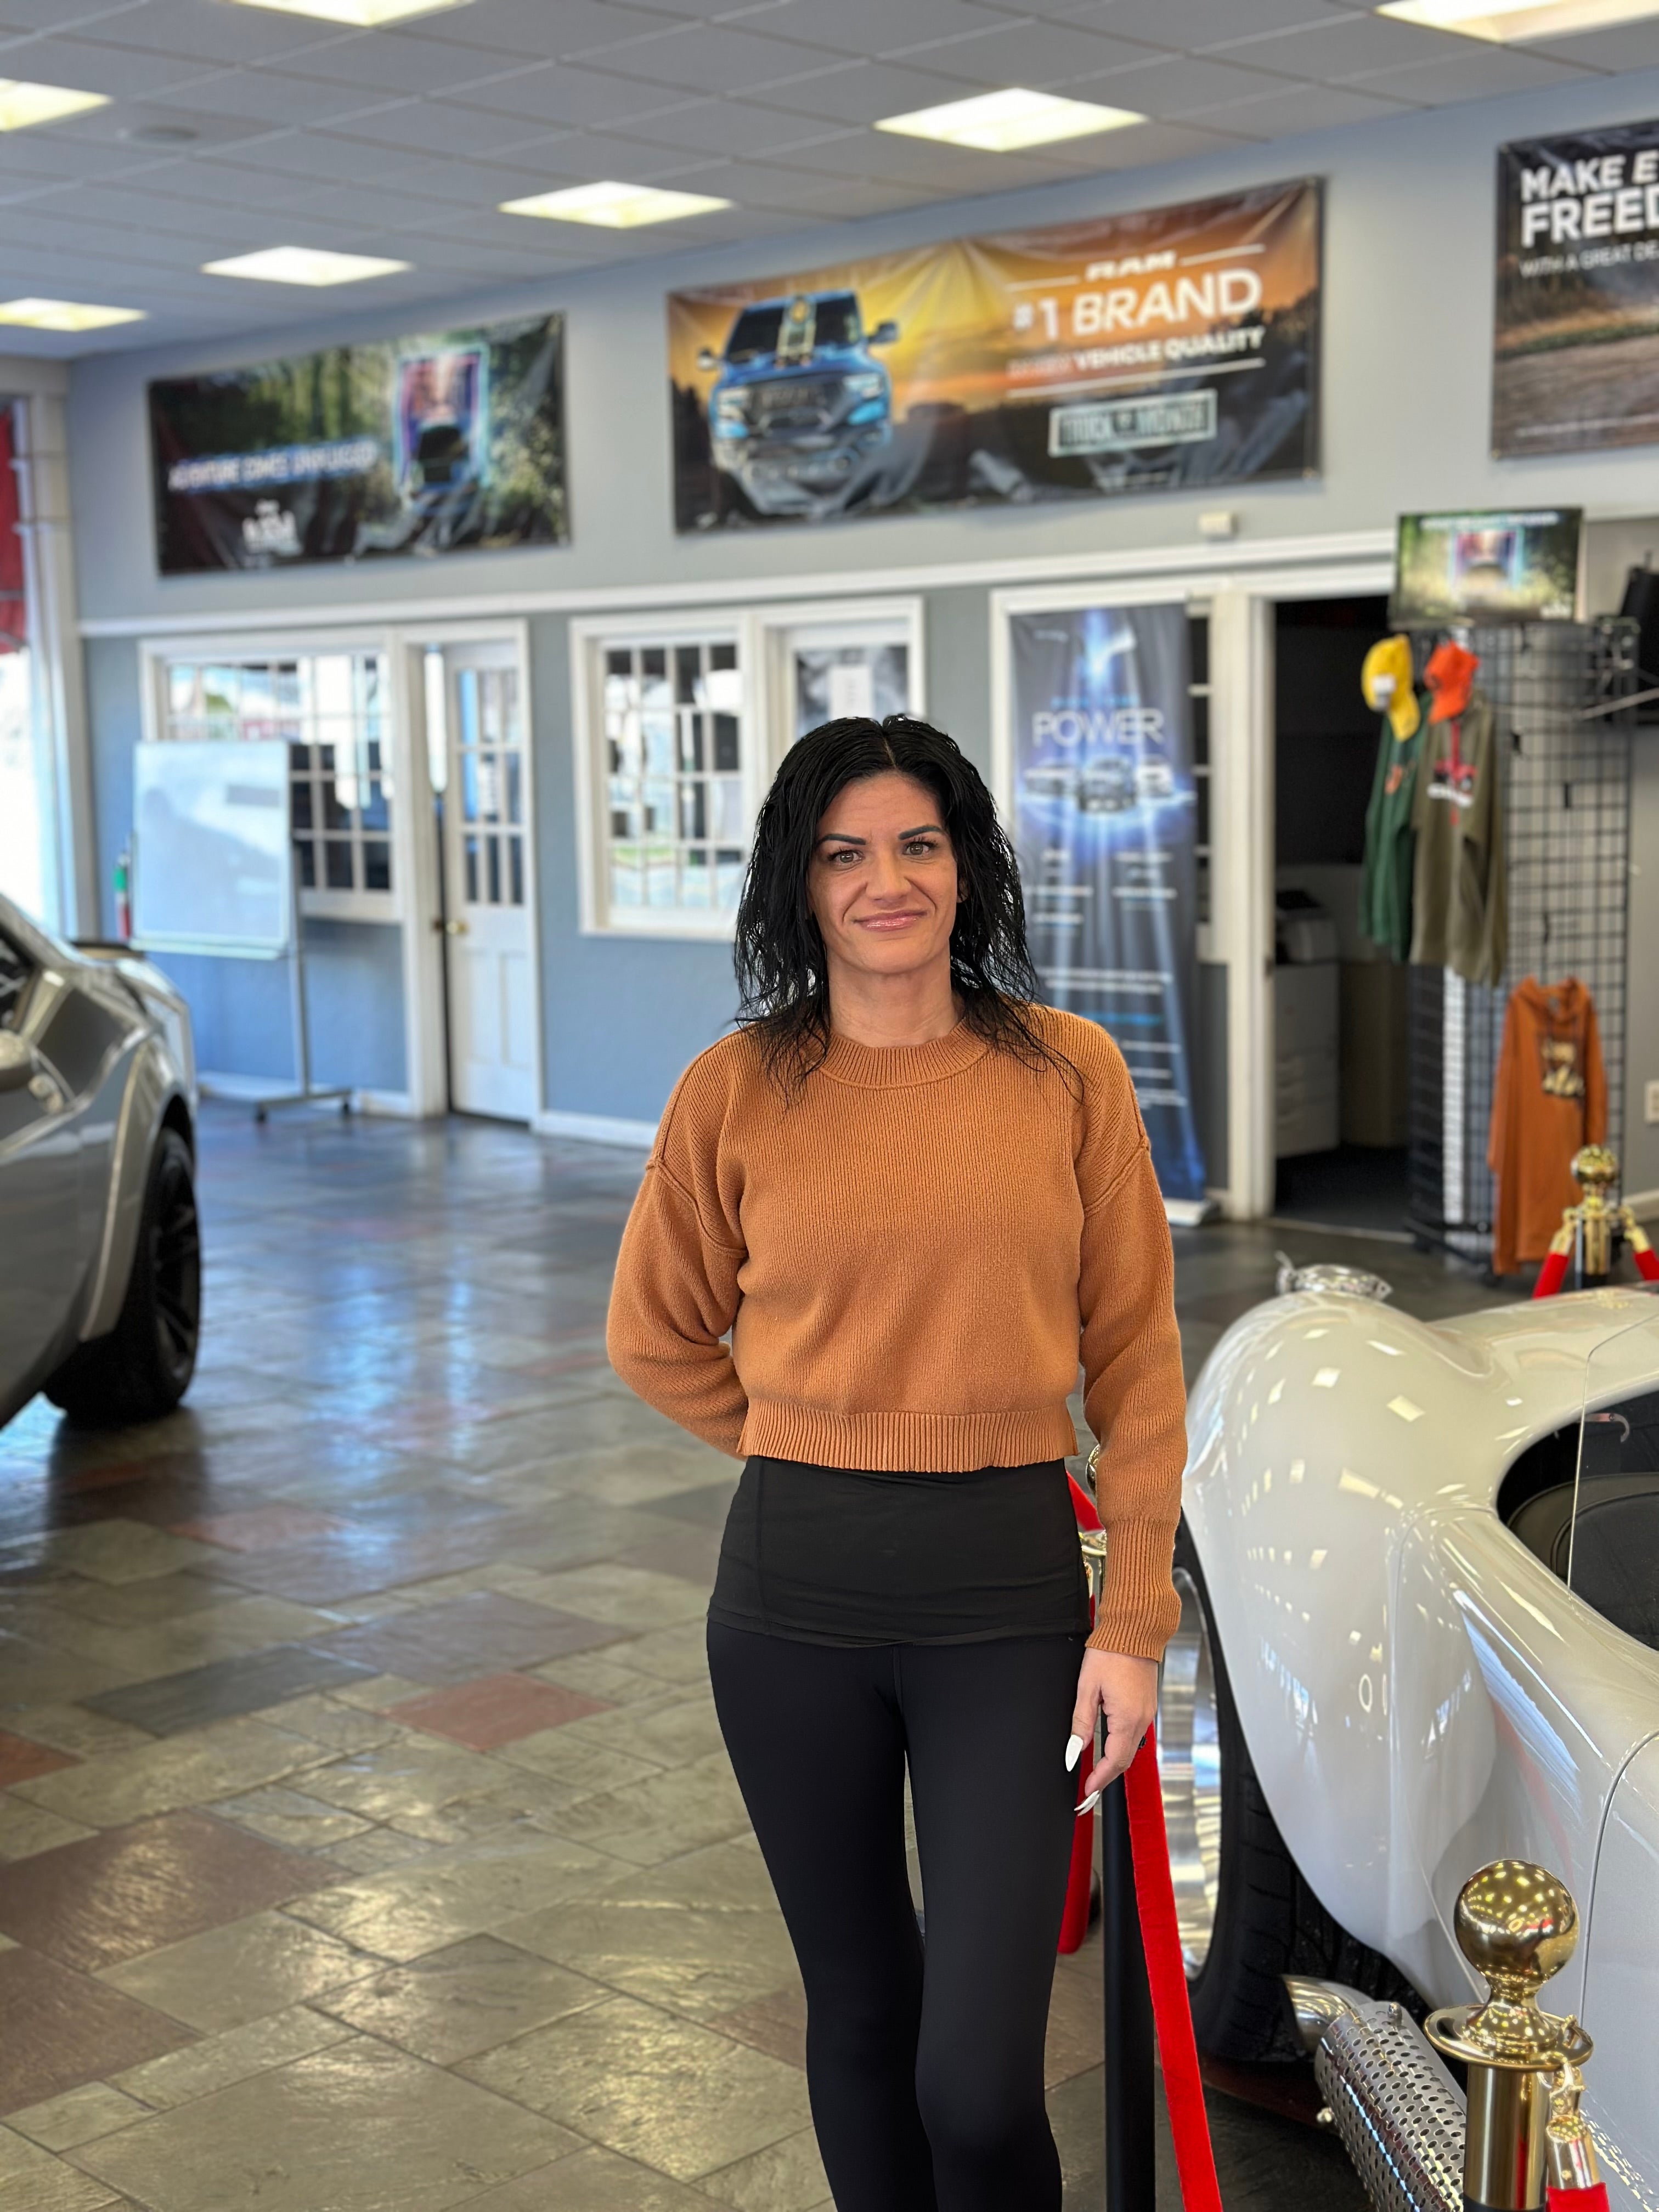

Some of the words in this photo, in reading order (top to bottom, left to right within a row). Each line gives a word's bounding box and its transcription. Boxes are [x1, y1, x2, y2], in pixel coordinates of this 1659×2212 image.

[1521, 154, 1626, 203] MAKE
[1085, 251, 1177, 281] RAM
[1519, 255, 1564, 278] WITH
[1565, 253, 1579, 272] A
[1071, 268, 1262, 336] BRAND
[1074, 338, 1162, 371] VEHICLE
[1164, 326, 1266, 362] QUALITY
[1031, 707, 1165, 747] POWER
